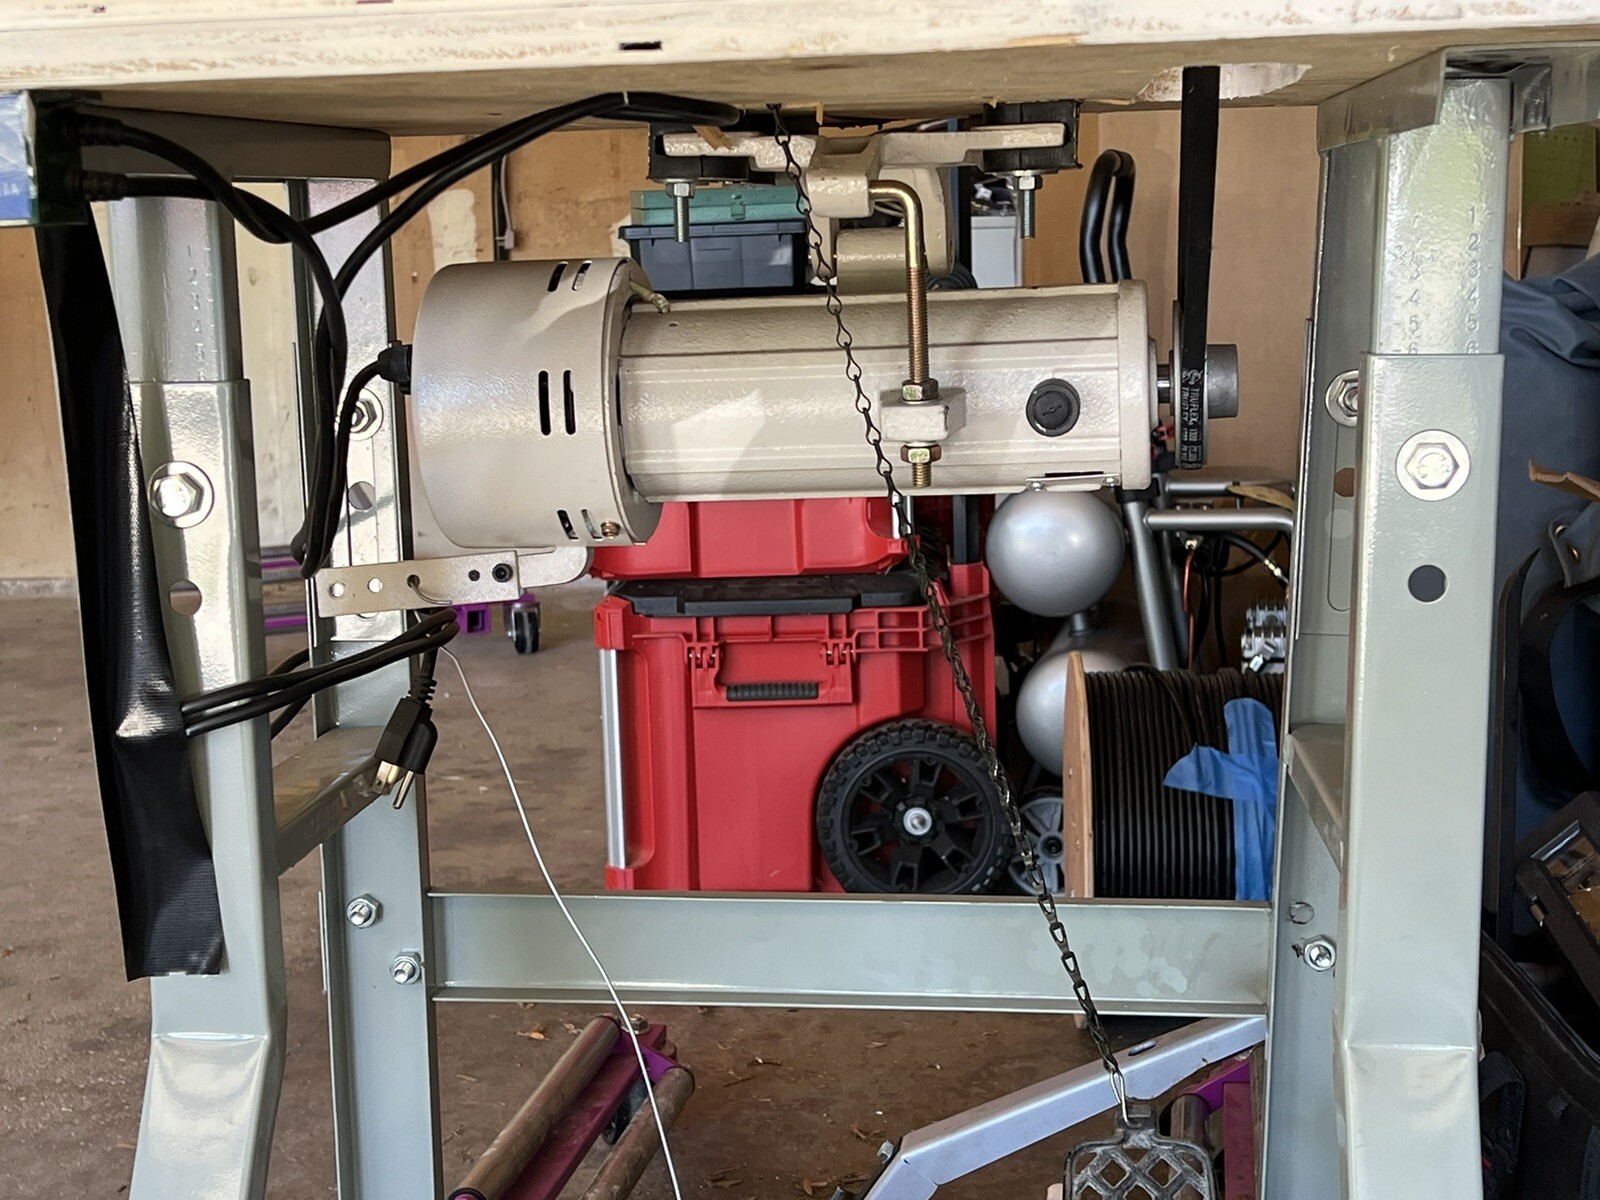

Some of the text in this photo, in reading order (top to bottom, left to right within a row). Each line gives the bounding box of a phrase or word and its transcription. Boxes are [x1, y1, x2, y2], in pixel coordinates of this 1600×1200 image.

[1468, 233, 1481, 251] 2
[188, 266, 199, 286] 2
[1468, 260, 1480, 278] 3
[1467, 287, 1480, 307] 4
[1409, 315, 1420, 334] 5
[1466, 313, 1480, 331] 5
